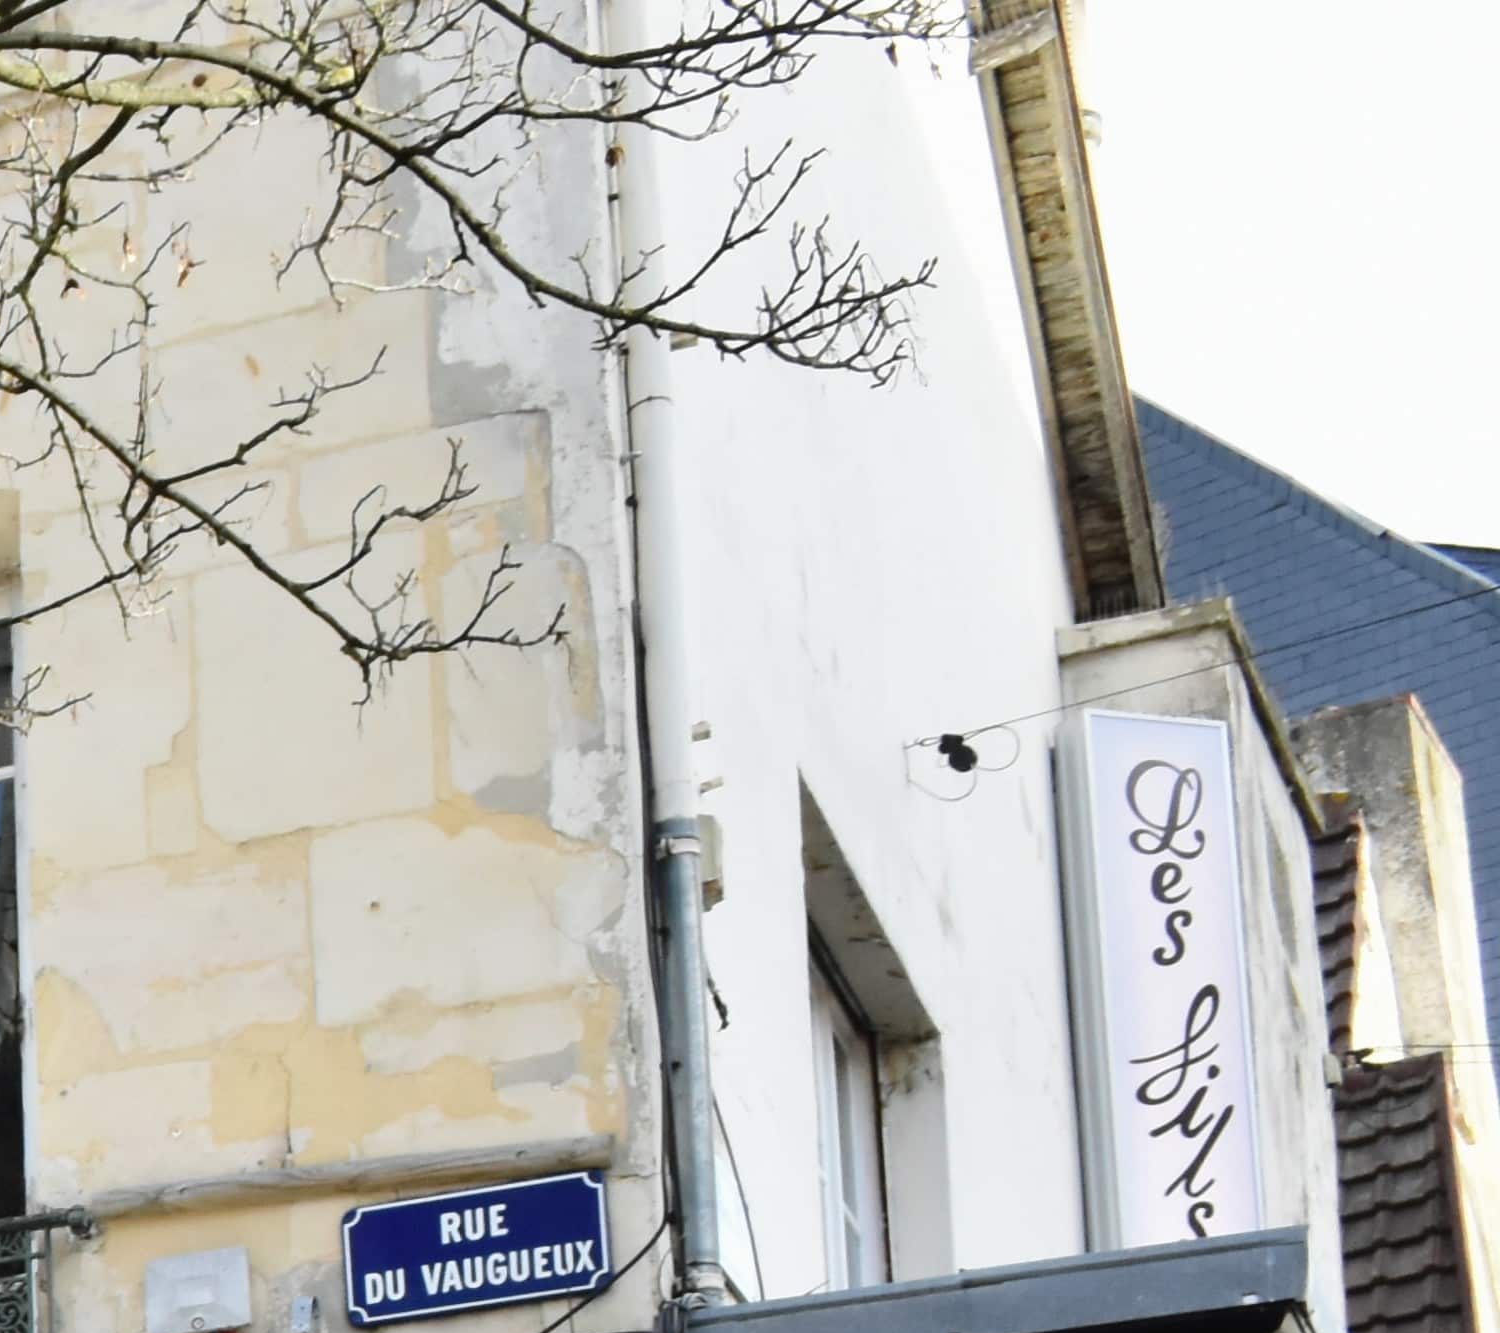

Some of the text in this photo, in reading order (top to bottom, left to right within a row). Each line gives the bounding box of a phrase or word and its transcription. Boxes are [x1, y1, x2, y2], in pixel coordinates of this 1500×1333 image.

[1126, 759, 1206, 967] Les
[439, 1203, 509, 1244] RUE
[363, 1239, 595, 1306] DU VAUGUEUX
